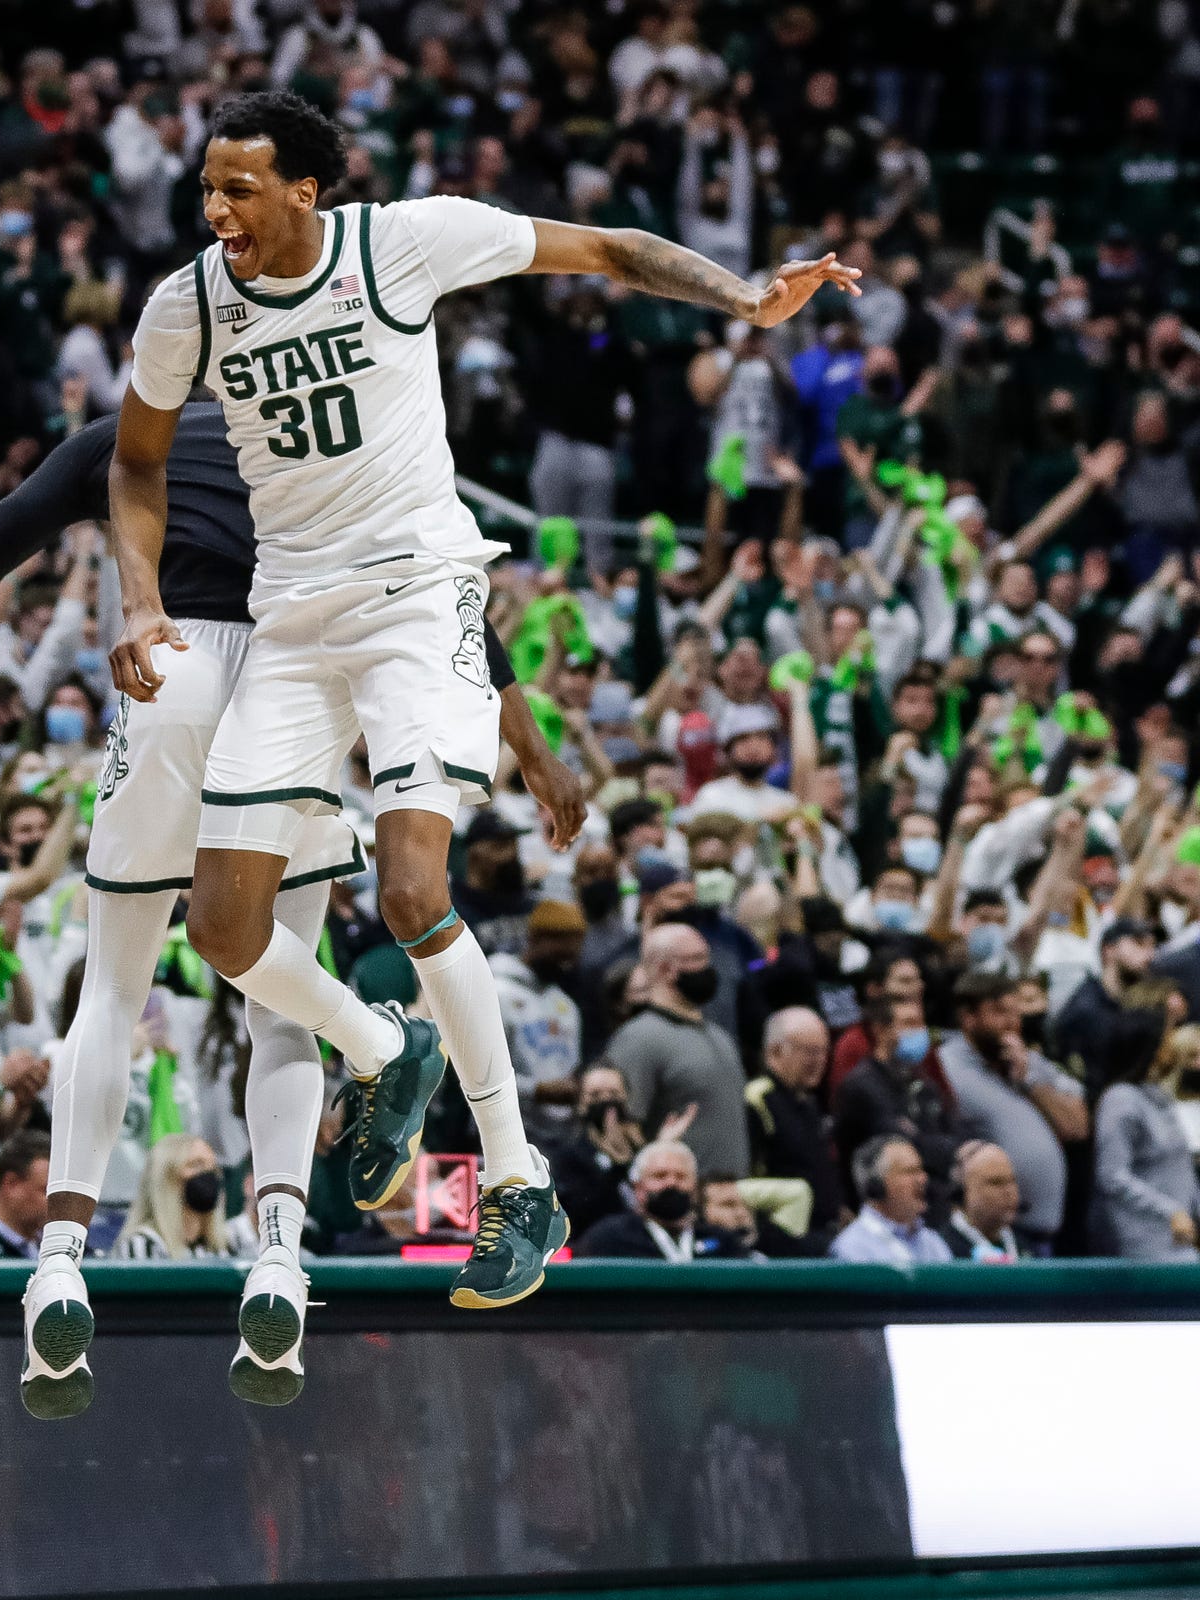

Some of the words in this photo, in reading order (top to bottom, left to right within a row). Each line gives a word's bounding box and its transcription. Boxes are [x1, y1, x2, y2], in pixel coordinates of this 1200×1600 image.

[217, 304, 245, 321] UNITY
[220, 320, 377, 401] STATE
[258, 383, 363, 459] 30
